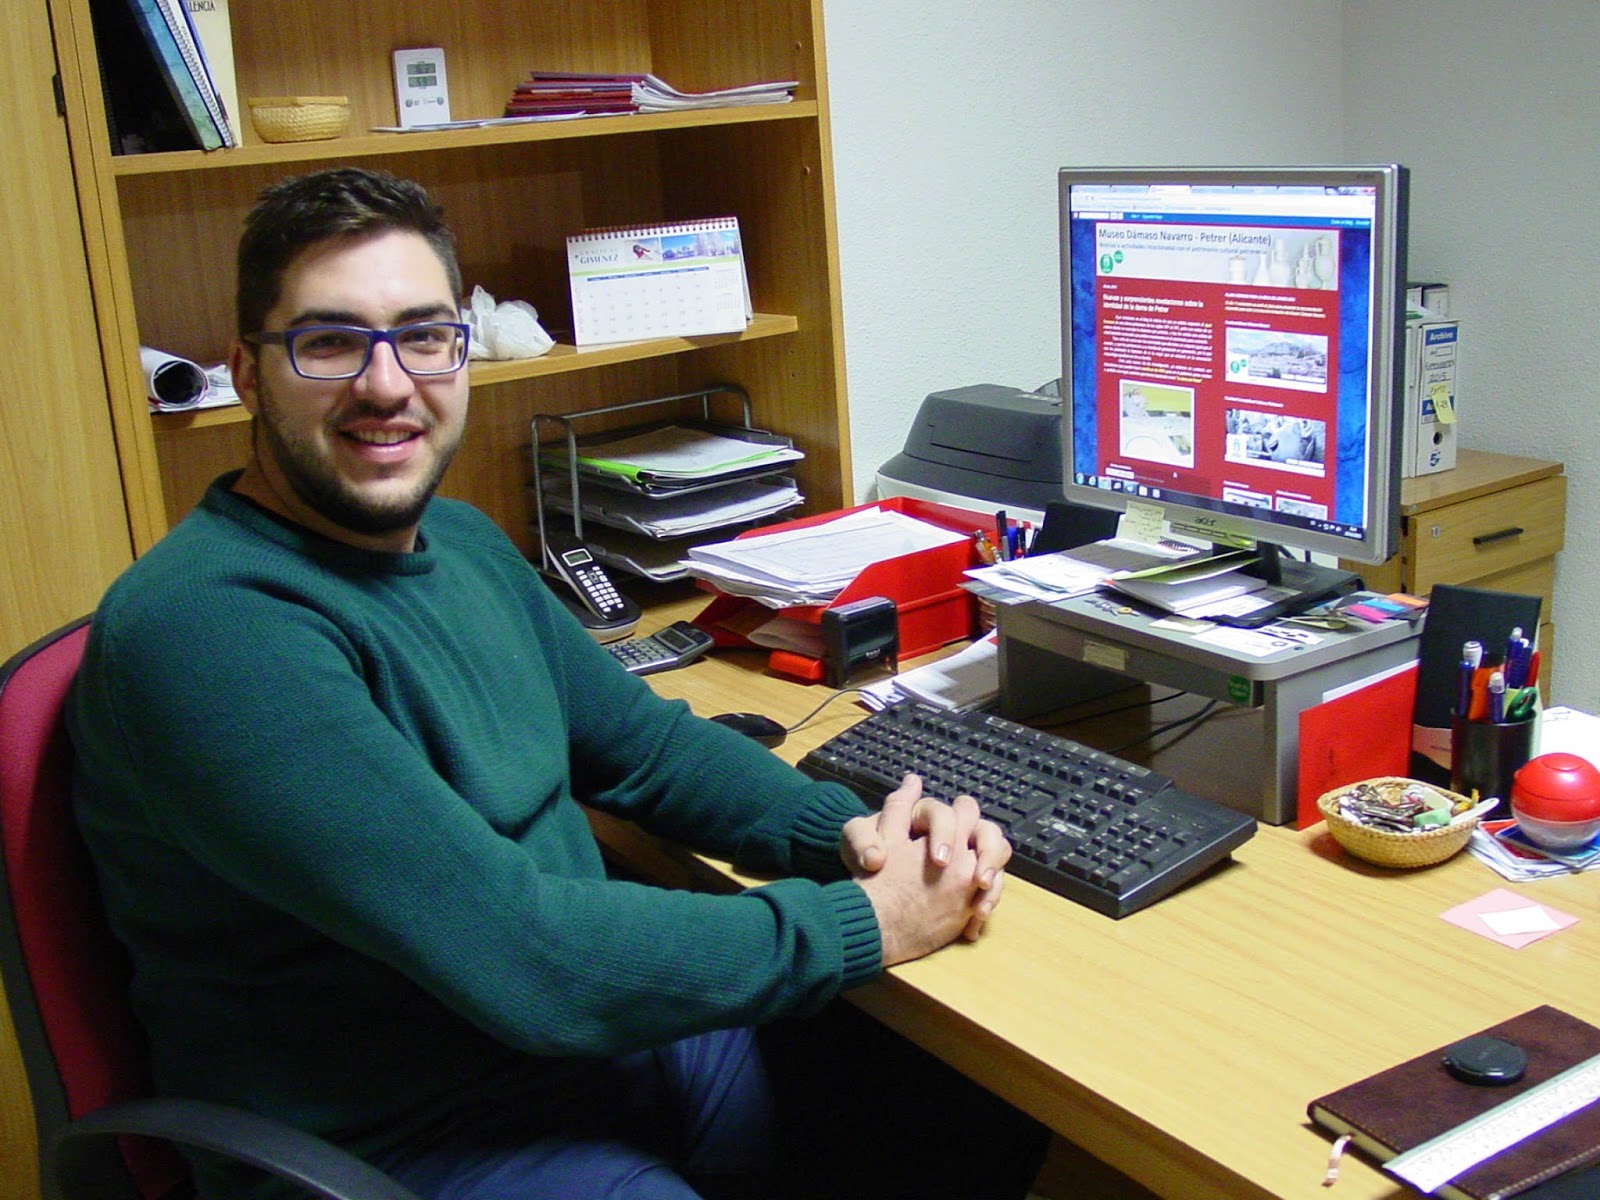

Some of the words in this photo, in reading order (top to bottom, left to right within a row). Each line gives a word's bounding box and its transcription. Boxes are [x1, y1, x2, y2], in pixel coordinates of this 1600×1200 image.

[188, 1, 216, 12] LENCIA
[1099, 229, 1125, 239] Museo
[1126, 228, 1158, 240] Dámaso
[1160, 231, 1193, 242] Navarro
[1200, 232, 1227, 242] Petrer
[1229, 233, 1271, 247] (Alicante)
[1429, 331, 1454, 341] Archivo
[1195, 516, 1216, 526] acer
